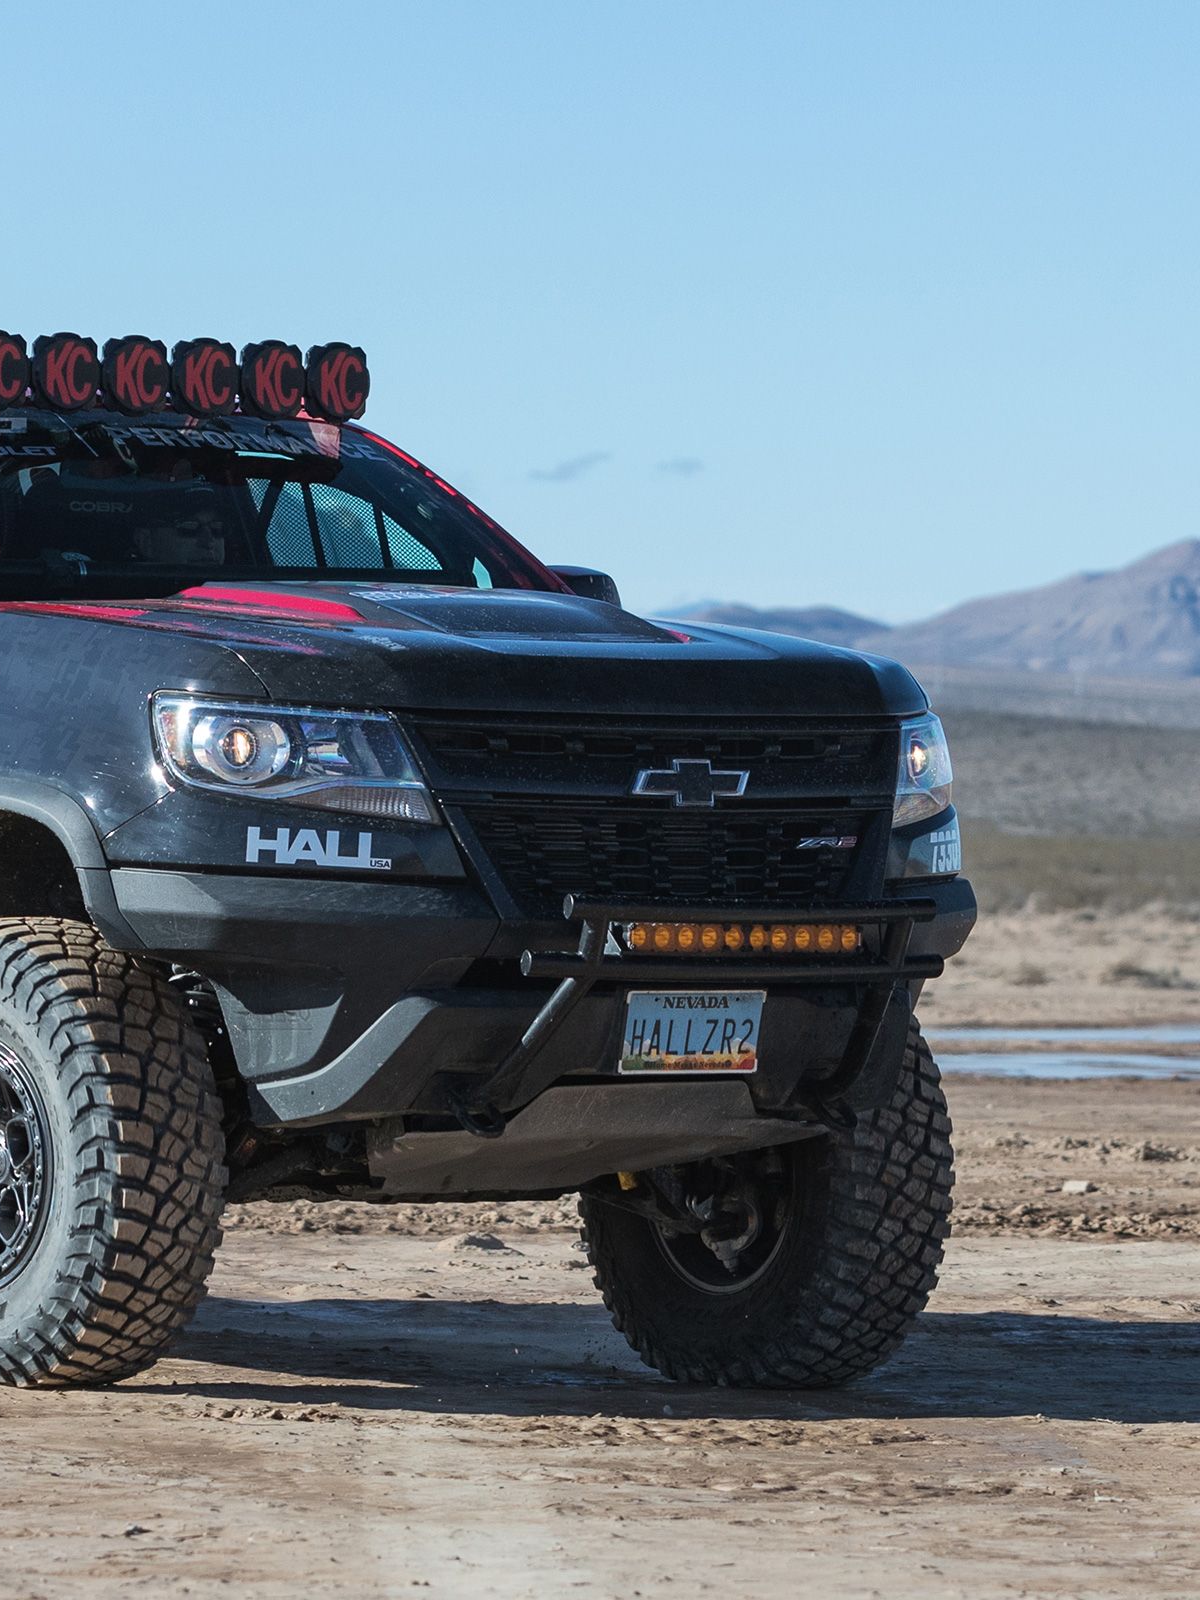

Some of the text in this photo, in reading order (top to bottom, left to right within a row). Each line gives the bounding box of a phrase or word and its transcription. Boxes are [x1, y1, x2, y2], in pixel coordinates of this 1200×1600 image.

[46, 341, 93, 405] KC
[115, 343, 162, 408] KC
[184, 346, 231, 410] KC
[254, 349, 299, 412] KC
[320, 351, 363, 415] KC
[102, 424, 388, 461] PERFORMANCE
[246, 826, 372, 869] HALL
[370, 860, 391, 869] USA
[662, 996, 730, 1009] NEVADA
[630, 1018, 754, 1056] HALLZR2
